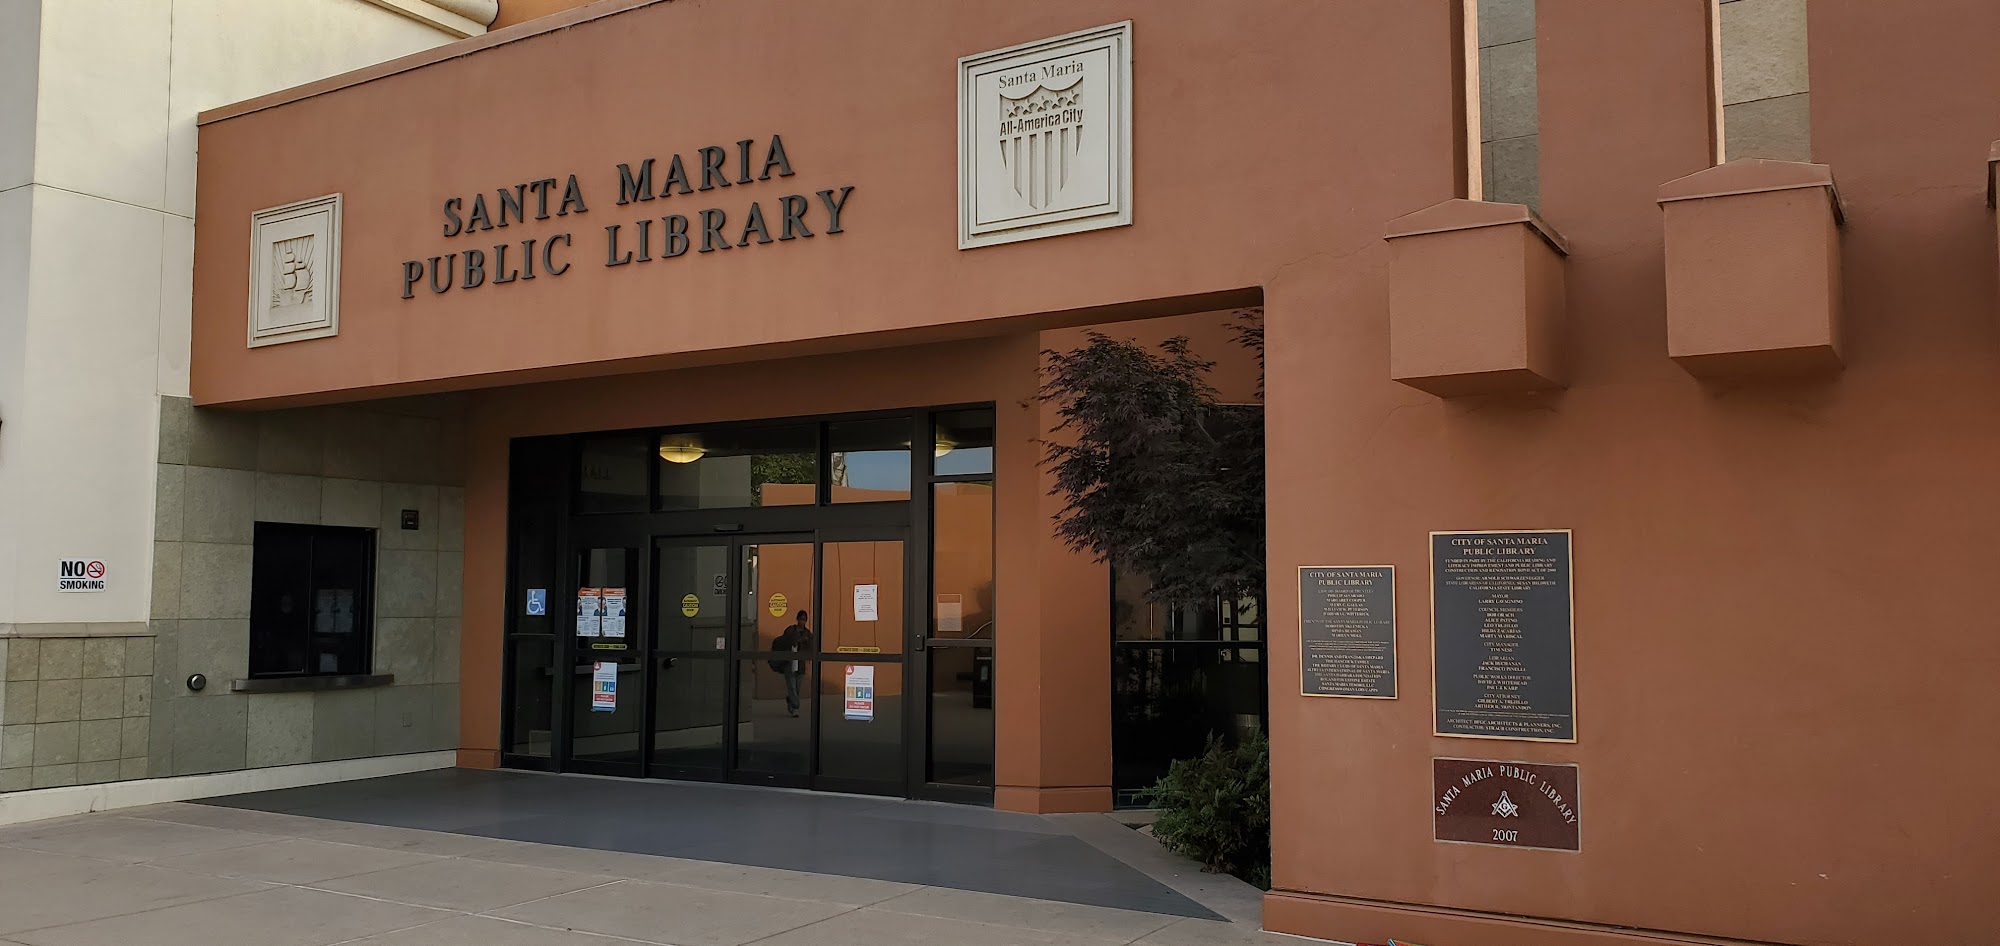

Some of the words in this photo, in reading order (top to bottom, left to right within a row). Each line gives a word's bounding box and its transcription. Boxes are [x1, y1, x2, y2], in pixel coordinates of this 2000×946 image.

[999, 71, 1036, 89] Santa
[1041, 60, 1084, 80] Maria
[1000, 113, 1060, 137] All-America
[1062, 108, 1084, 124] City
[443, 173, 588, 238] SANTA
[615, 134, 796, 206] MARIA
[401, 232, 572, 300] PUBLIC
[604, 184, 856, 268] LIBRARY
[61, 560, 86, 577] NO
[60, 580, 104, 590] SMOKING
[1436, 785, 1461, 816] SANTA
[1461, 766, 1494, 788] MARIA
[1500, 765, 1537, 785] PUBLIC
[1539, 781, 1577, 825] LIBRARY
[1492, 829, 1518, 842] 2007
